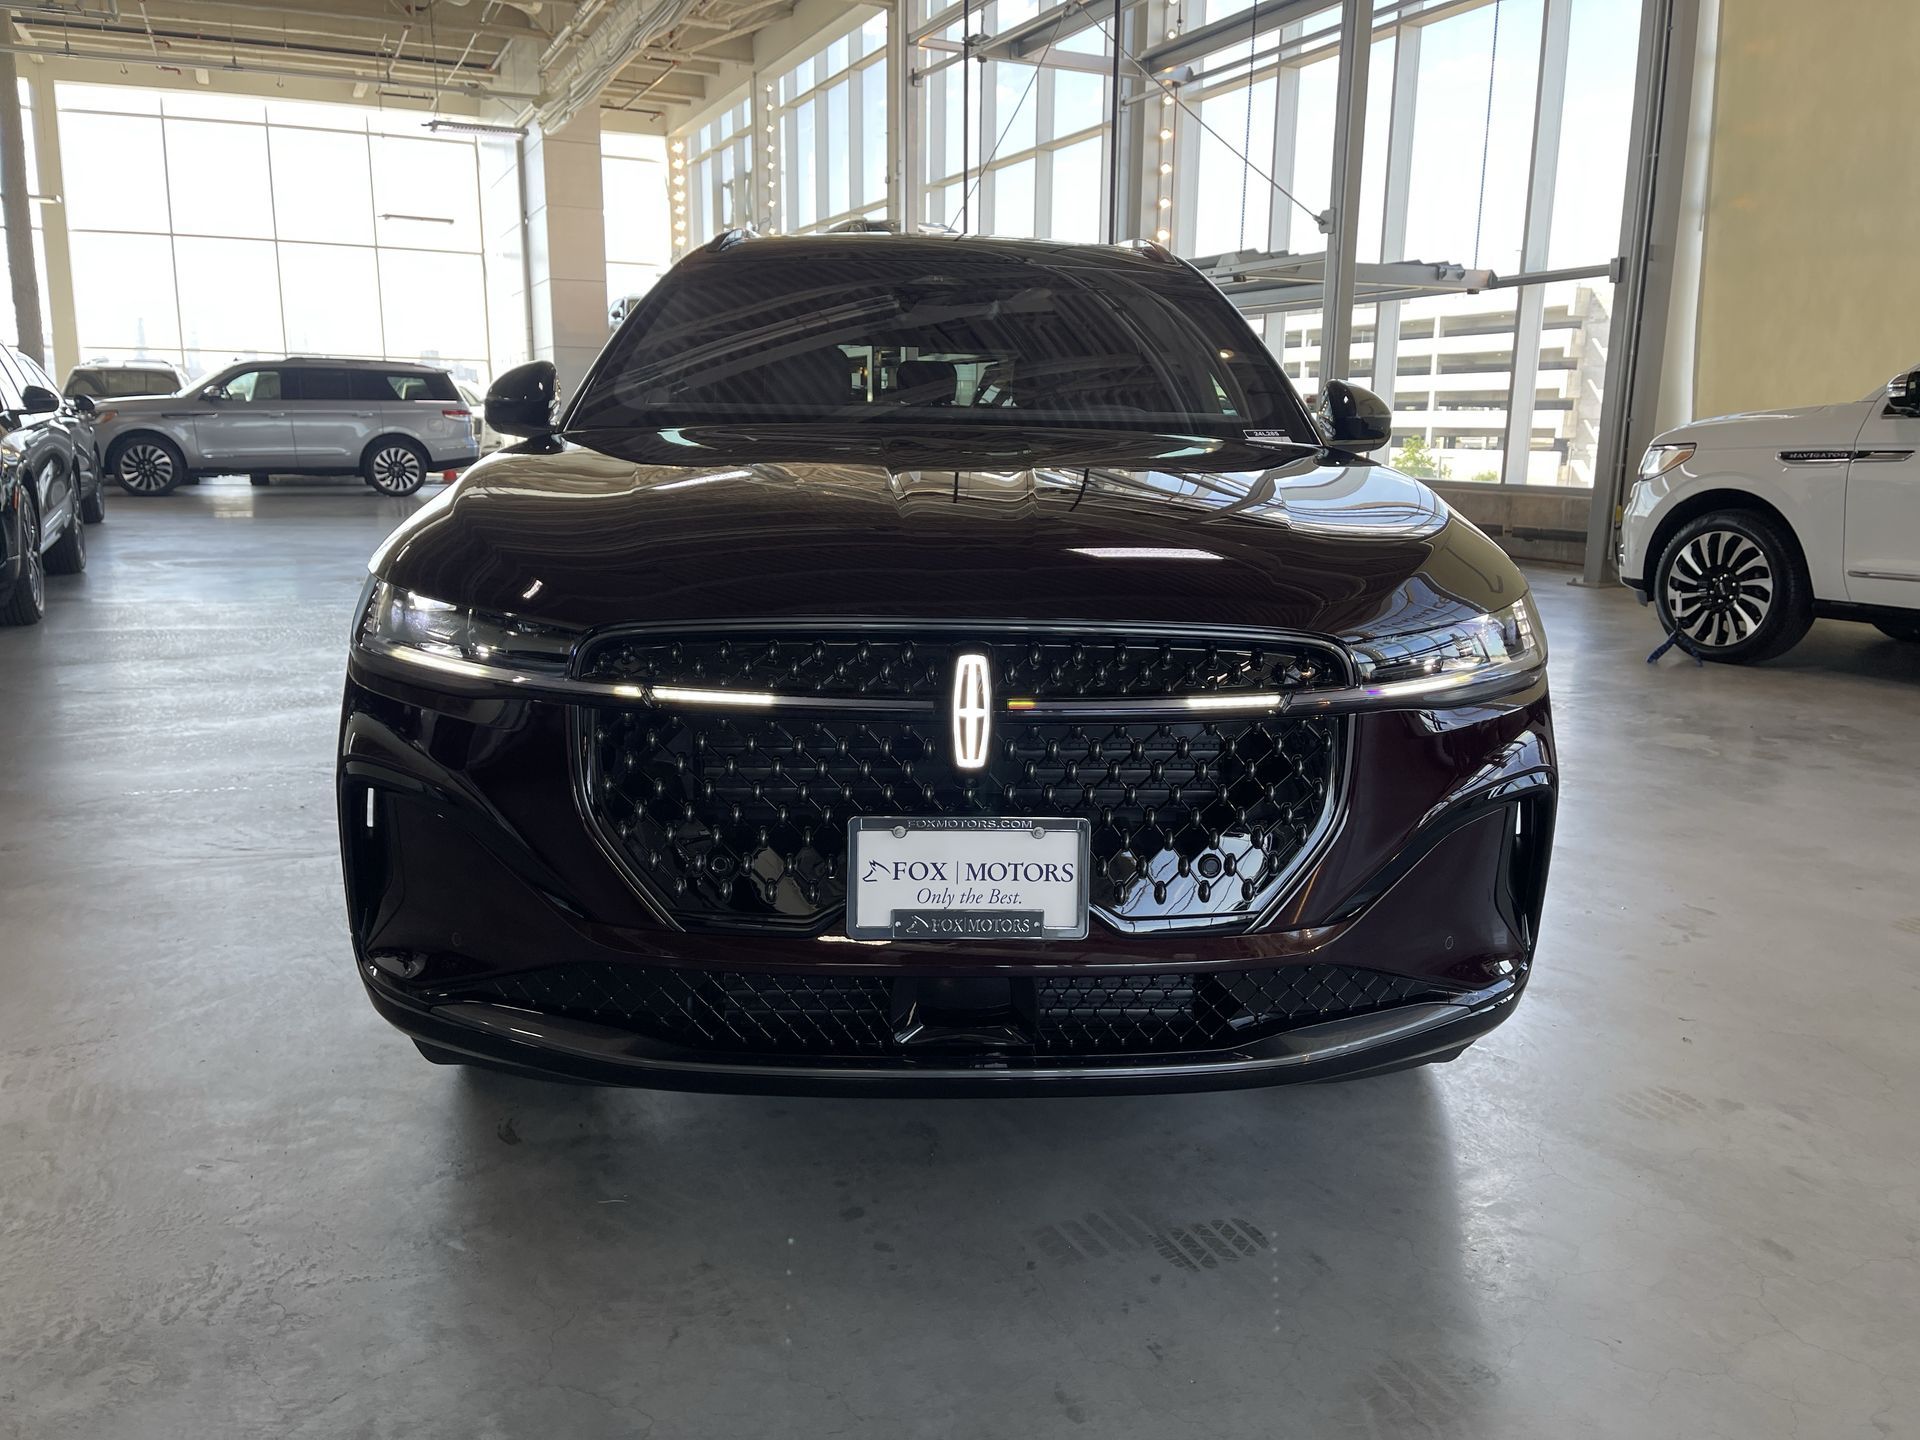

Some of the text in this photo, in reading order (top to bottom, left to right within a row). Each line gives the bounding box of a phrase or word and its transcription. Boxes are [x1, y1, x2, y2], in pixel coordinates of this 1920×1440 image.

[907, 819, 1033, 829] FOXMOTORS.COM
[892, 861, 1074, 883] FOX MOTORS
[916, 887, 1022, 910] Only the Best.
